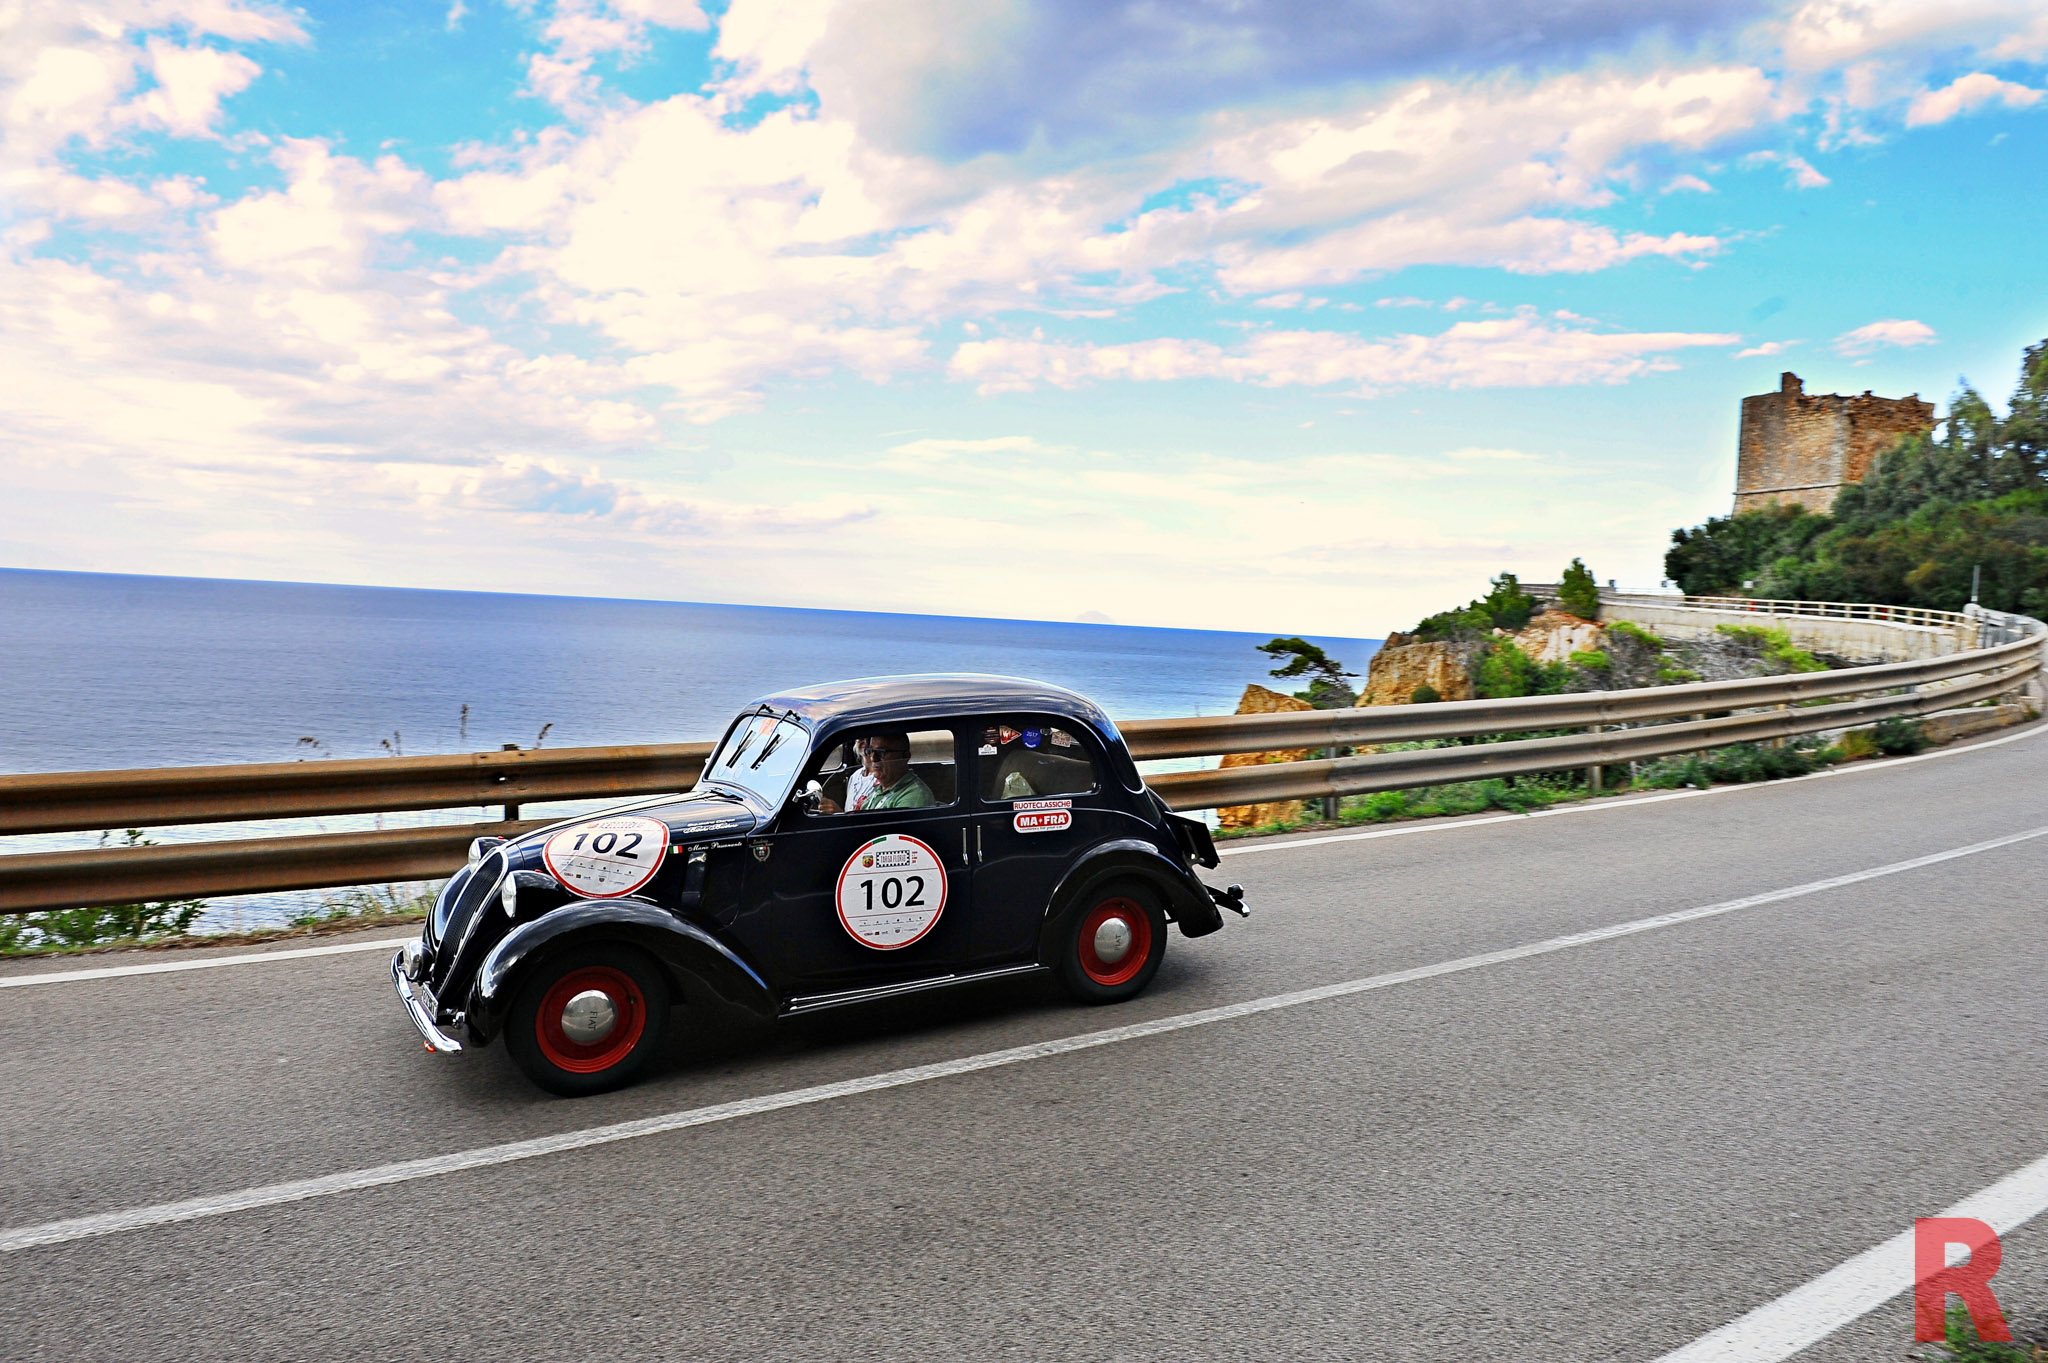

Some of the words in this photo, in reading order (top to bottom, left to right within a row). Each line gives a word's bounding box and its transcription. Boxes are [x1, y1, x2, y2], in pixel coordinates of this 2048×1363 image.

[573, 833, 642, 859] 102
[860, 876, 924, 910] 102
[588, 1011, 597, 1030] FIAT
